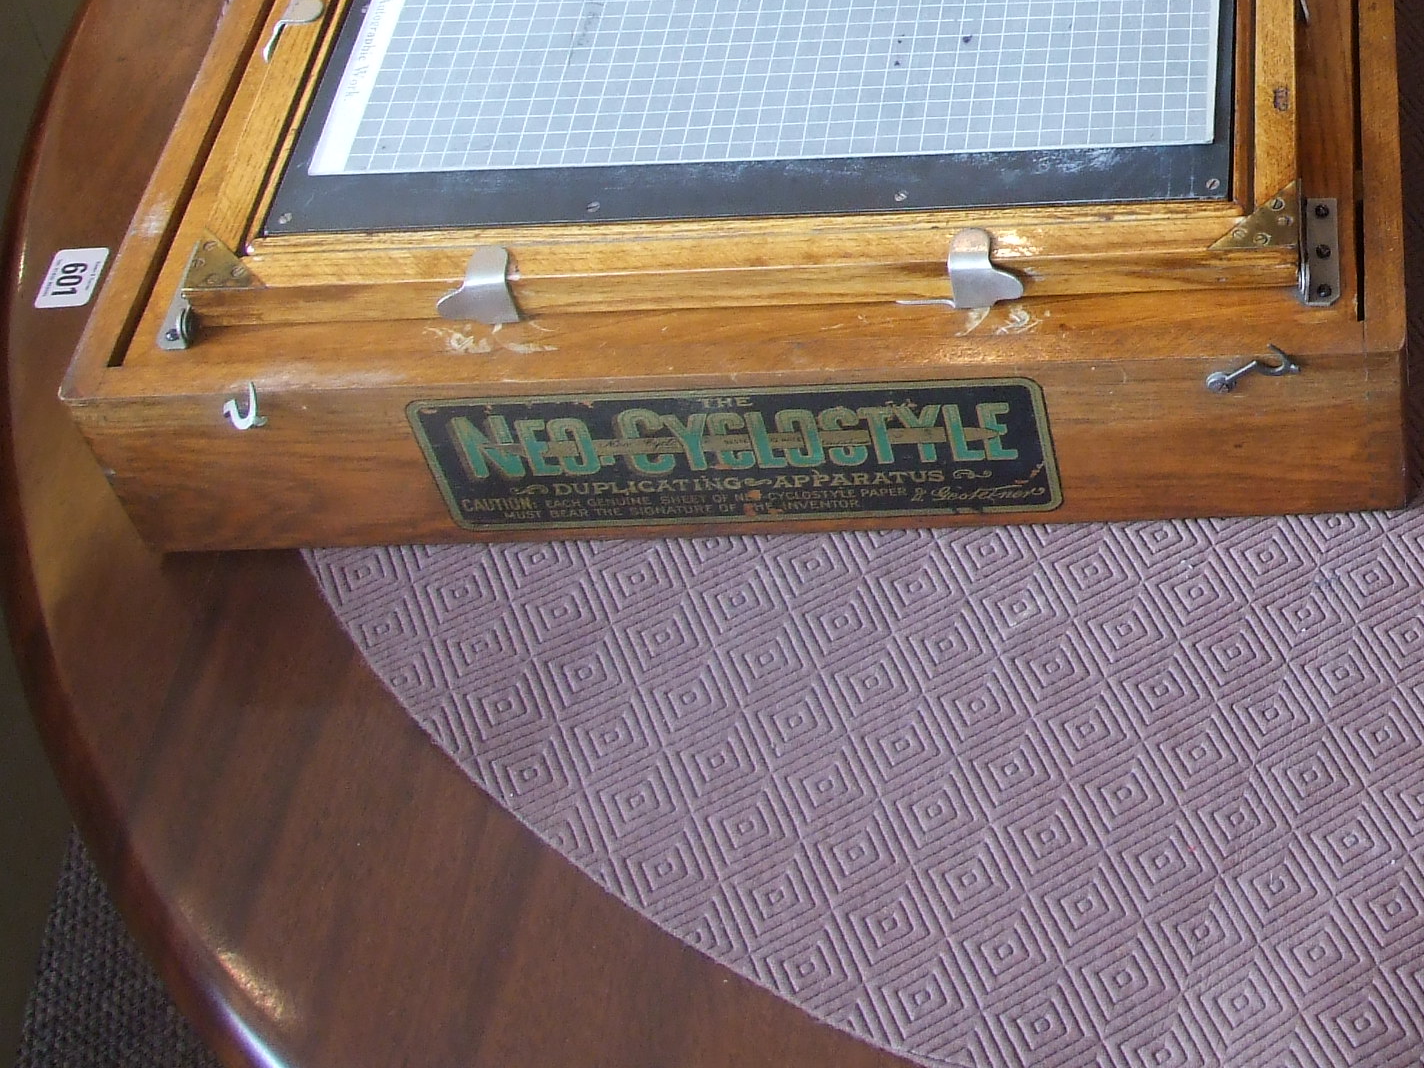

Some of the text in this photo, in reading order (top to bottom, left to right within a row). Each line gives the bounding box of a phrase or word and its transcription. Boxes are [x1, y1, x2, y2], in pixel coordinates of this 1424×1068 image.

[51, 262, 88, 295] 601
[702, 396, 753, 409] THE
[448, 402, 1018, 478] NEO-CYCLOSTYLE
[553, 469, 945, 496] DUPLICATING APPARATUS
[503, 510, 542, 519] MUST
[550, 509, 589, 518] BEAR
[596, 507, 623, 517] THE
[629, 503, 713, 516] SIGNATURE
[719, 503, 736, 513] OF
[782, 499, 860, 511] INVENTOR
[545, 497, 581, 508] EACH
[587, 495, 650, 507] GENUINE
[660, 492, 706, 504] SHEET
[713, 492, 728, 503] OF
[861, 487, 908, 498] PAPER
